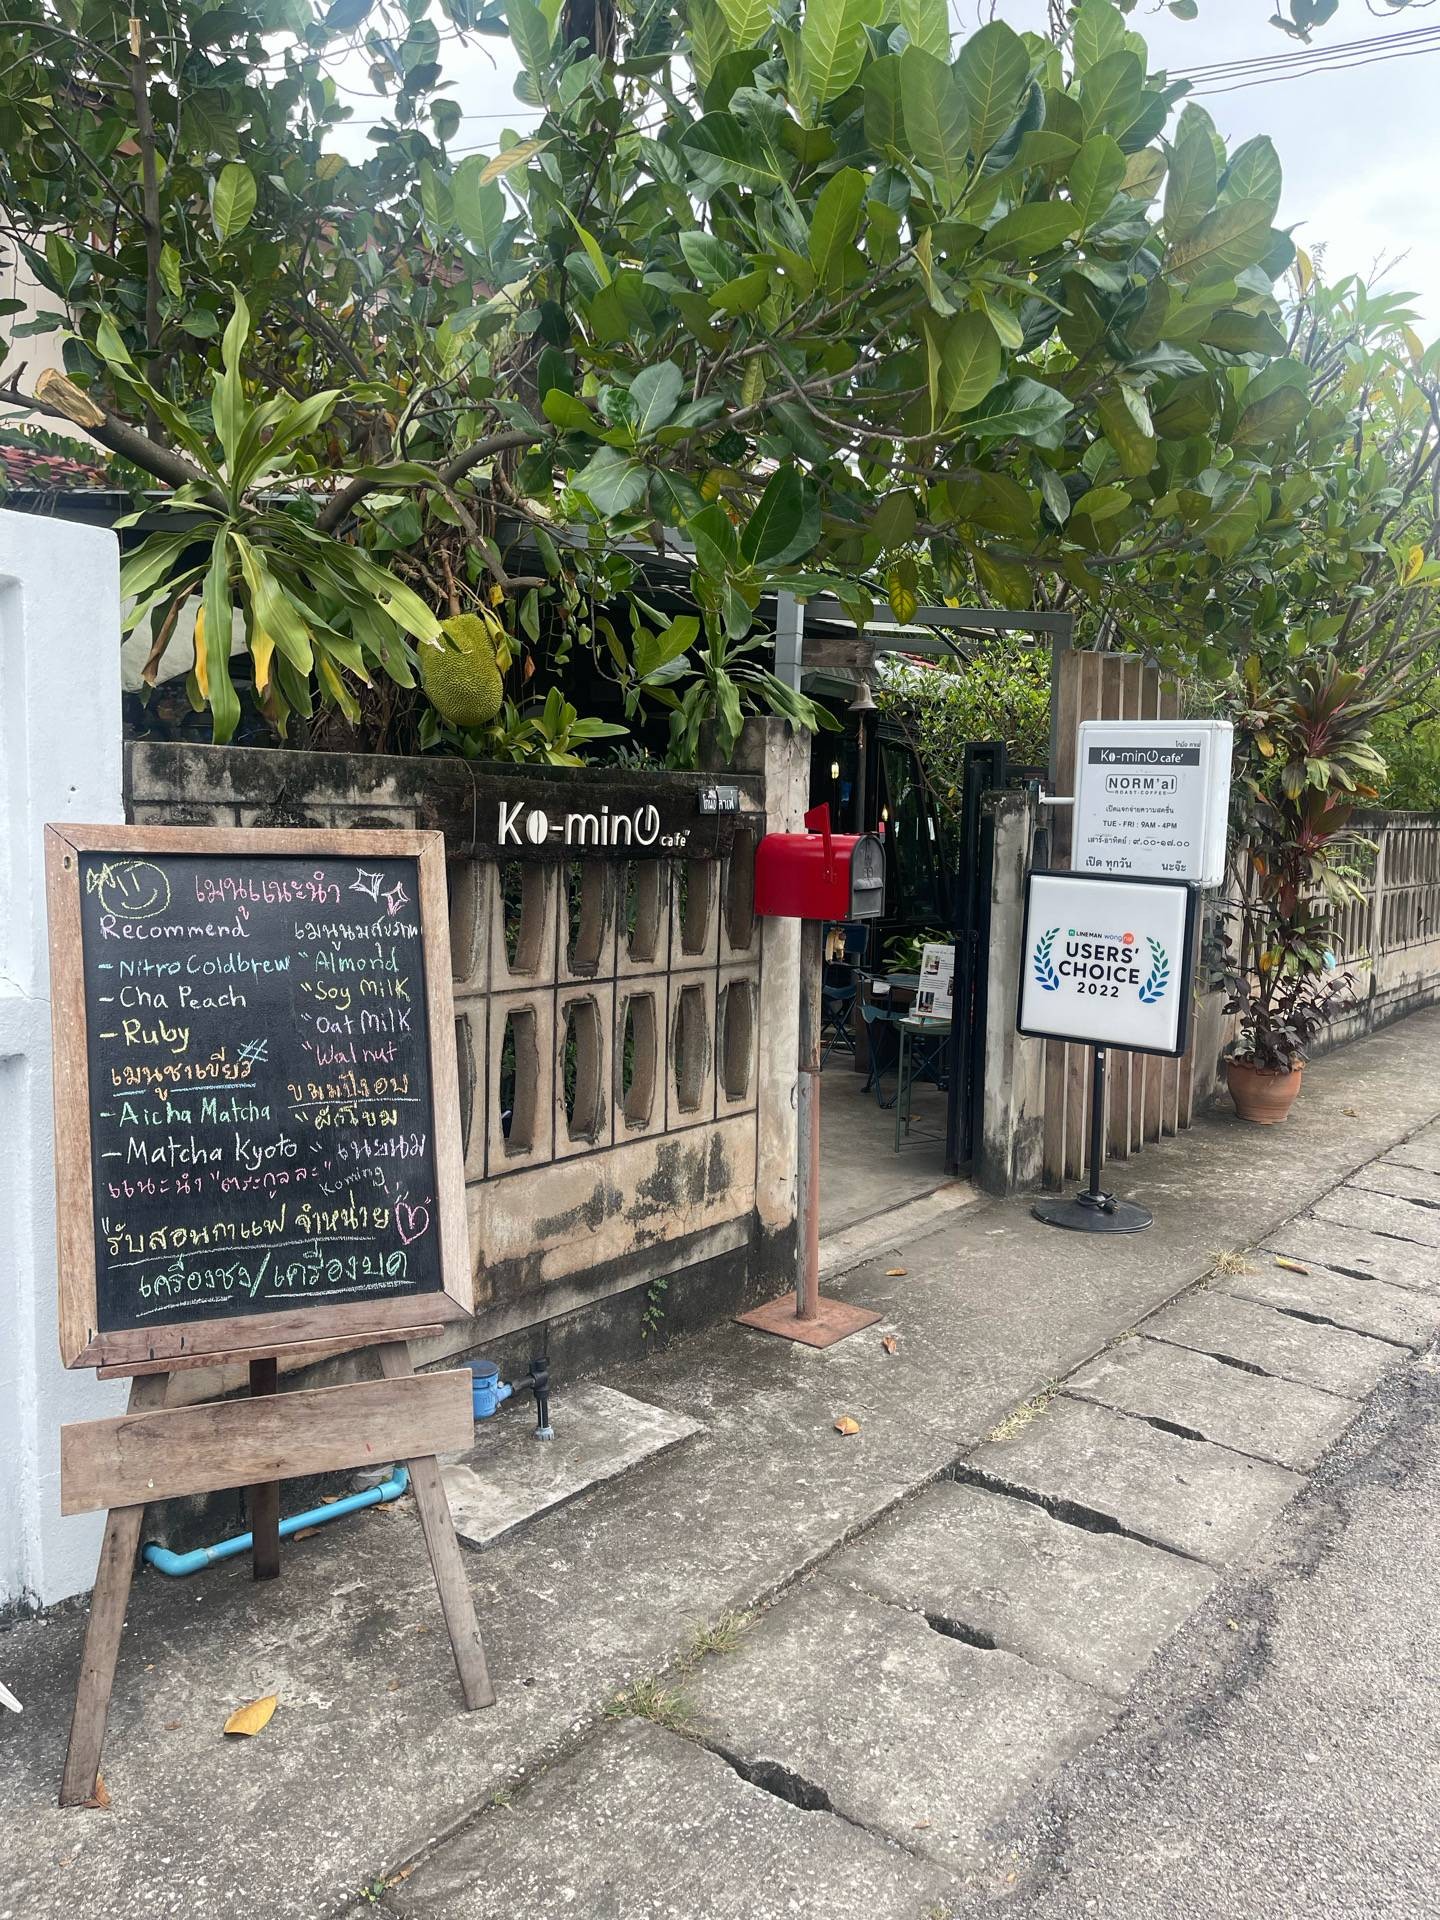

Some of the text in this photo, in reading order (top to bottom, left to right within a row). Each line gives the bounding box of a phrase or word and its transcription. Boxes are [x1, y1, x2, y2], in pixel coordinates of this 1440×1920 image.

[1141, 821, 1156, 829] 9AM
[1085, 856, 1103, 867] เปิด
[1105, 857, 1132, 871] ทุกวัน
[195, 871, 340, 920] เมนูแนะนำ
[100, 914, 250, 940] Recommend
[1058, 960, 1140, 985] CHOICE
[120, 985, 169, 1008] Cha
[178, 985, 247, 1009] Peach
[1077, 981, 1119, 998] 2022
[122, 1018, 190, 1054] Ruby
[111, 1046, 252, 1101] เมนูชาเขียว
[119, 1101, 192, 1127] Aicha
[200, 1096, 271, 1125] Matcha
[127, 1136, 223, 1168] Matcha
[235, 1132, 297, 1171] Kyoto
[108, 1172, 202, 1199] แนะนำ
[294, 1189, 390, 1235] จำหน่าย
